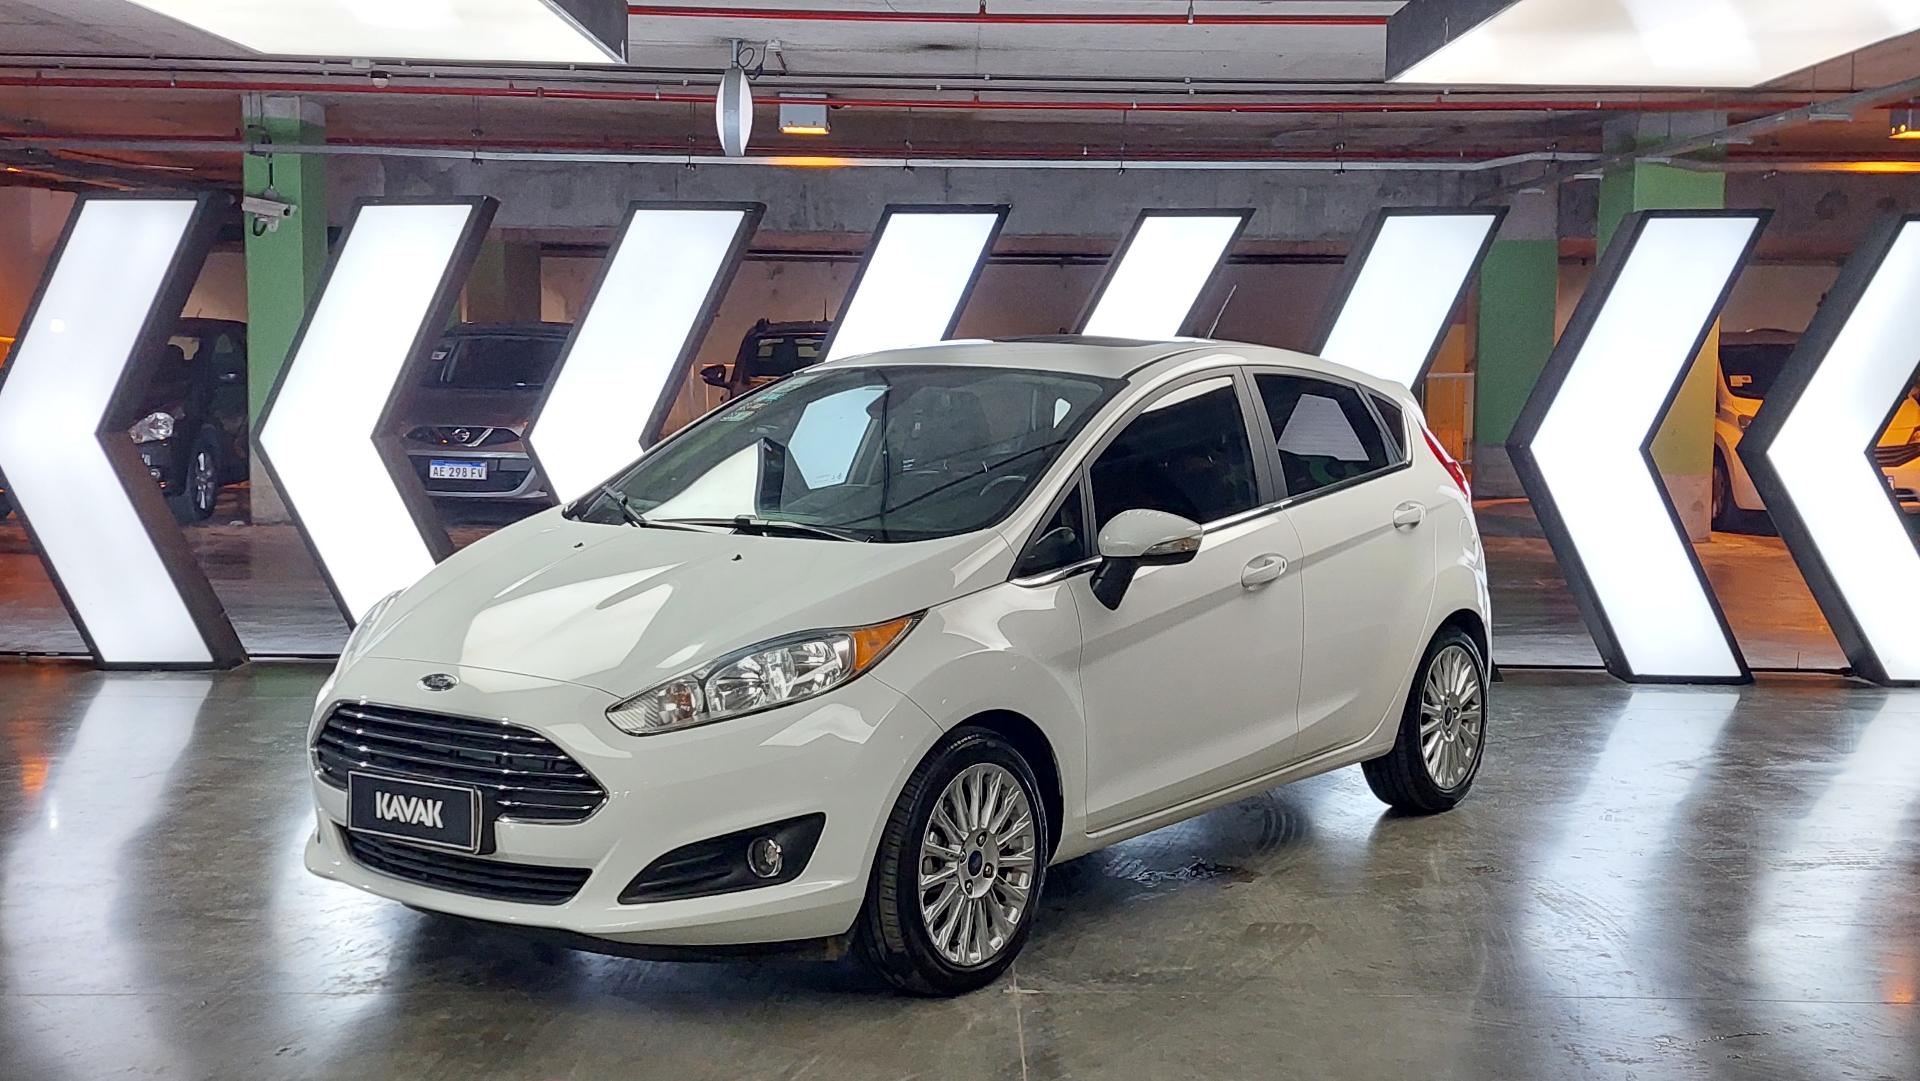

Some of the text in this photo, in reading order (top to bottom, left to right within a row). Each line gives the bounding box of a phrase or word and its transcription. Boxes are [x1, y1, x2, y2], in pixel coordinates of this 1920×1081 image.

[432, 466, 484, 478] AE 298 FV
[375, 791, 444, 829] KAVAK
